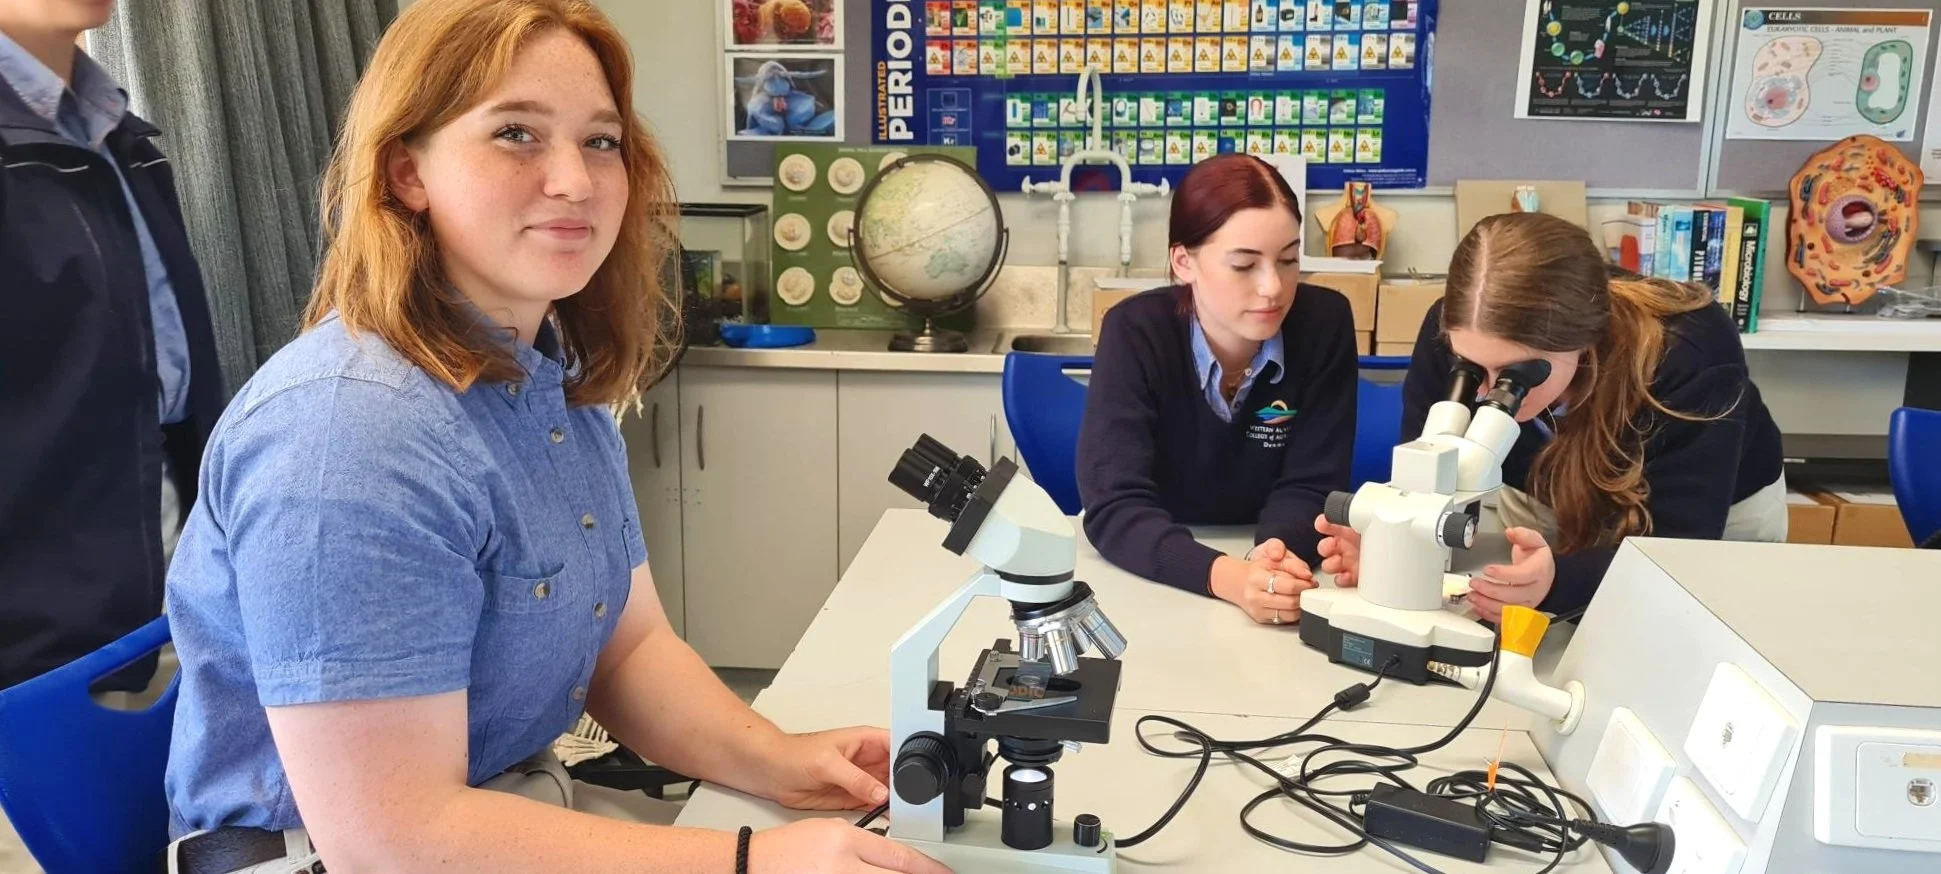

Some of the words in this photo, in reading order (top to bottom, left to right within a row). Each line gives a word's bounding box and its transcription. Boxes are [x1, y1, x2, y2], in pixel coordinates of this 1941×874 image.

[1767, 25, 1809, 33] EUKARYOTIC
[1834, 26, 1860, 34] ANIMAL
[1768, 11, 1802, 21] CELLS
[886, 0, 914, 140] PERIOD
[877, 61, 888, 140] ILLUSTRATED
[1693, 250, 1705, 281] PATHOL
[1739, 240, 1756, 302] Microbiology
